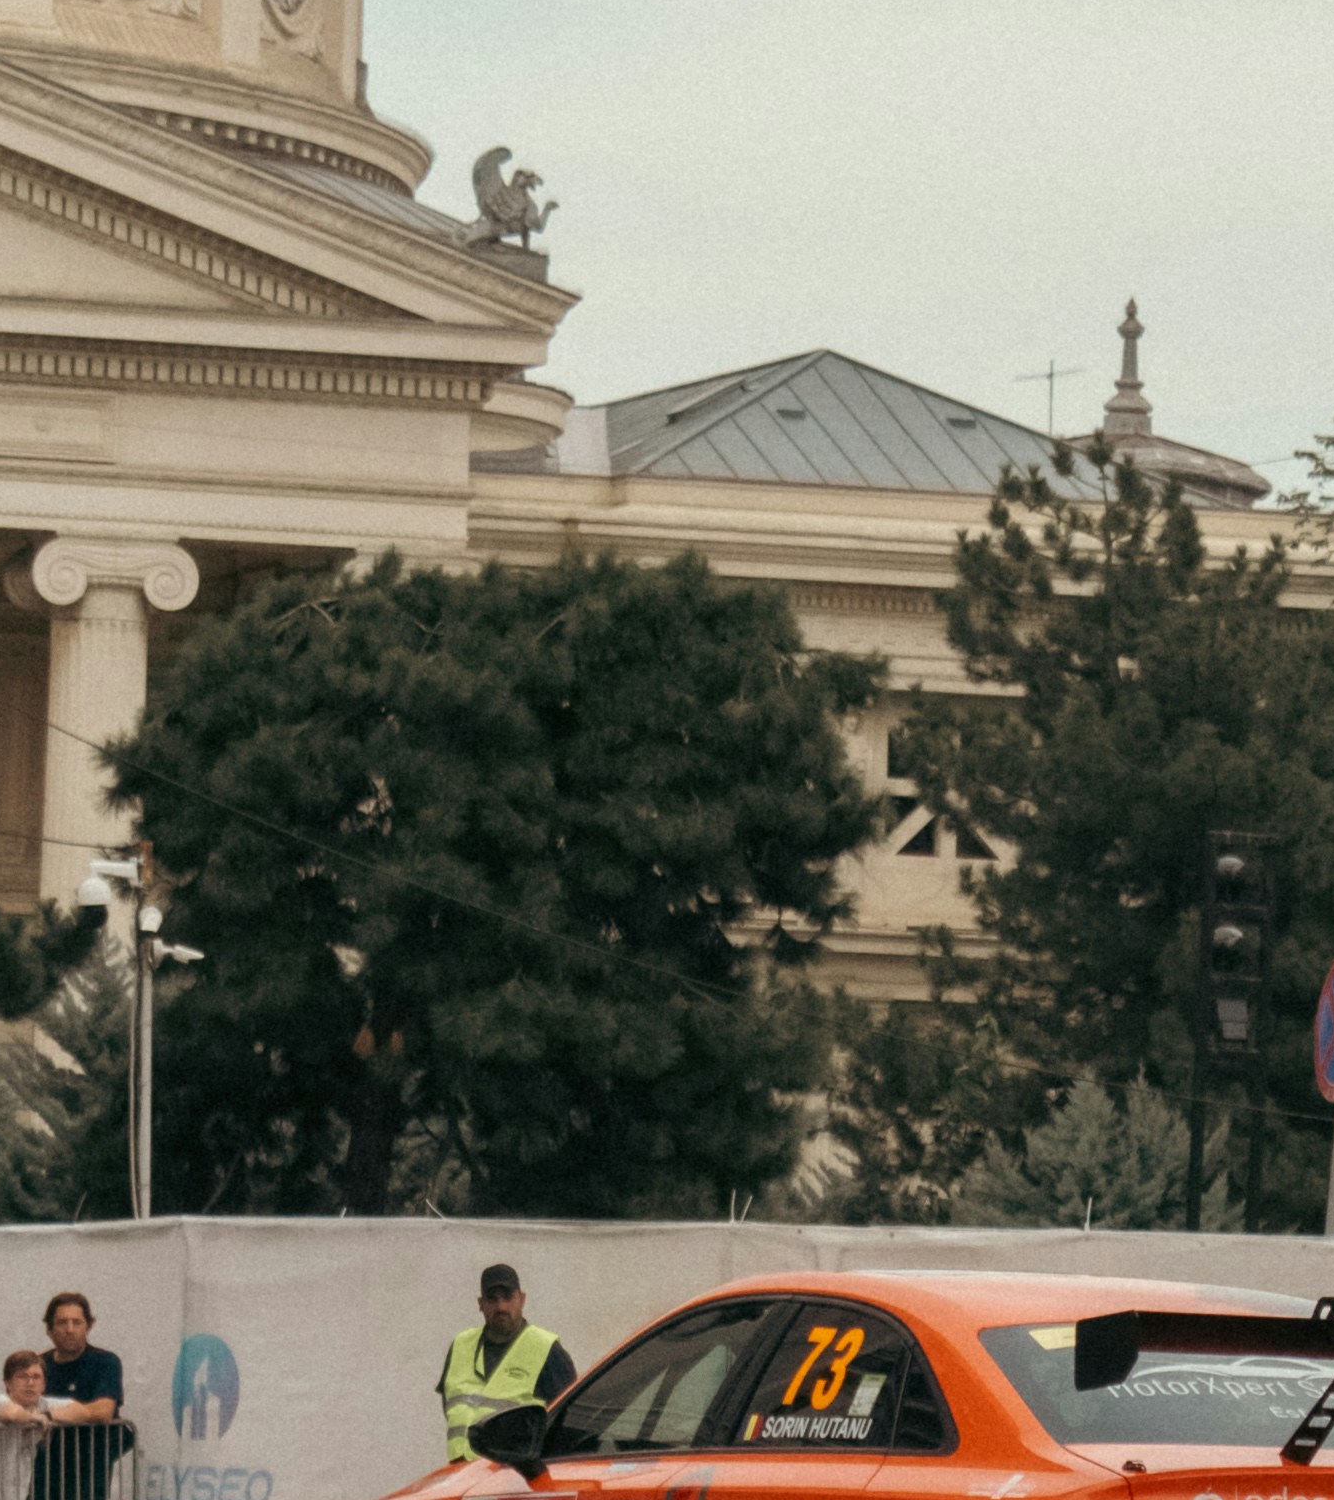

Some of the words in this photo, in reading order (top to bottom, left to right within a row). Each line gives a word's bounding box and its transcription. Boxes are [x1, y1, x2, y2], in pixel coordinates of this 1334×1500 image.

[782, 1326, 865, 1410] 73
[1106, 1376, 1296, 1400] MotorXpert
[761, 1416, 810, 1439] SORIN
[809, 1417, 873, 1440] HUTANU
